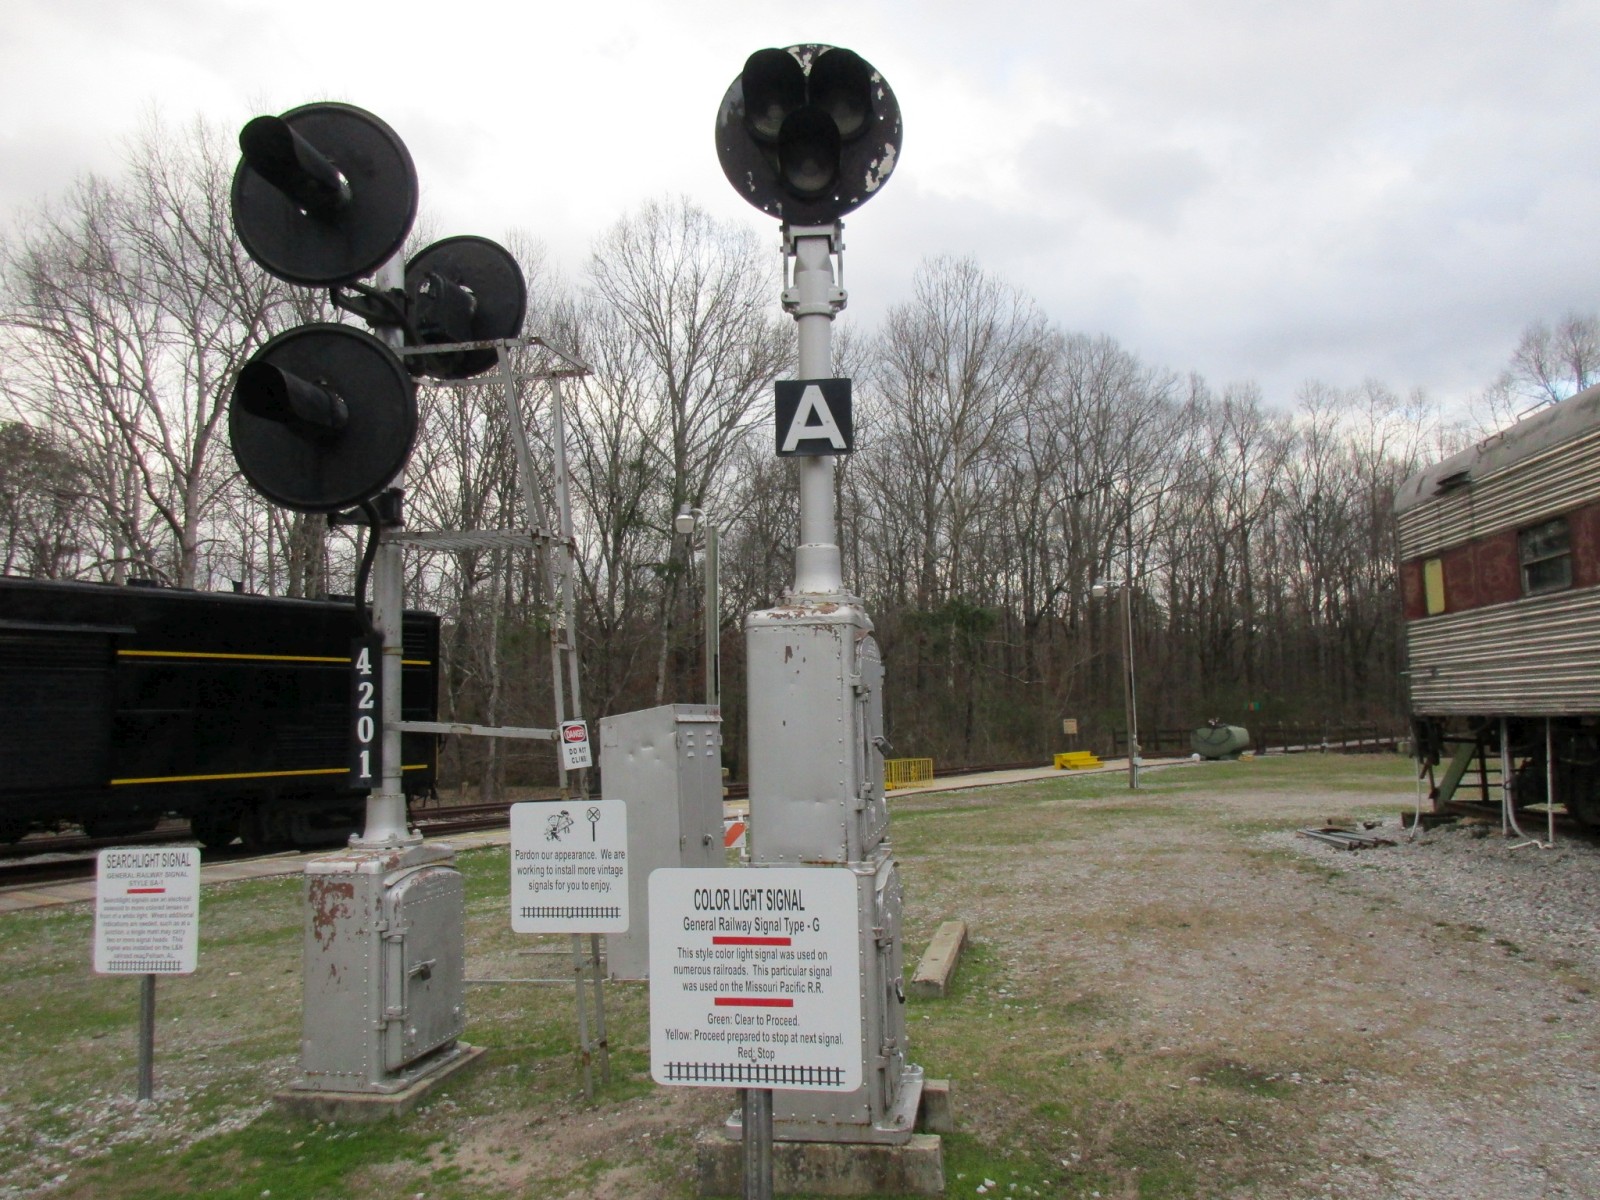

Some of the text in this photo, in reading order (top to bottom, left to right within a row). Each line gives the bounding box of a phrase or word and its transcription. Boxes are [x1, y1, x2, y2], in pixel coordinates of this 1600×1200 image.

[781, 385, 847, 451] A
[355, 647, 374, 778] 4201
[107, 853, 191, 868] SEARCHLIGHT SIGNAL
[515, 849, 625, 861] Pardon our appearance. We are
[517, 866, 544, 877] working
[546, 866, 554, 875] to
[555, 865, 576, 875] install
[597, 865, 623, 877] vintage
[529, 880, 611, 892] signals for you to enjoy.
[694, 888, 805, 911] COLOR LIGHT SIGNAL
[683, 917, 716, 931] General
[719, 917, 751, 934] Railway
[755, 918, 781, 935] Signal
[784, 918, 804, 935] Type
[812, 918, 820, 932] G
[677, 947, 827, 963] This style color light signal was used on
[674, 965, 832, 979] numerous railroads. This particular signal
[683, 981, 824, 993] was used on the Missouri Pacific R.R.
[707, 1013, 800, 1026] Green: Clear to Proceed.
[665, 1029, 844, 1047] Yellow: Proceed prepared to stop at next signal.
[758, 1048, 775, 1061] Stop
